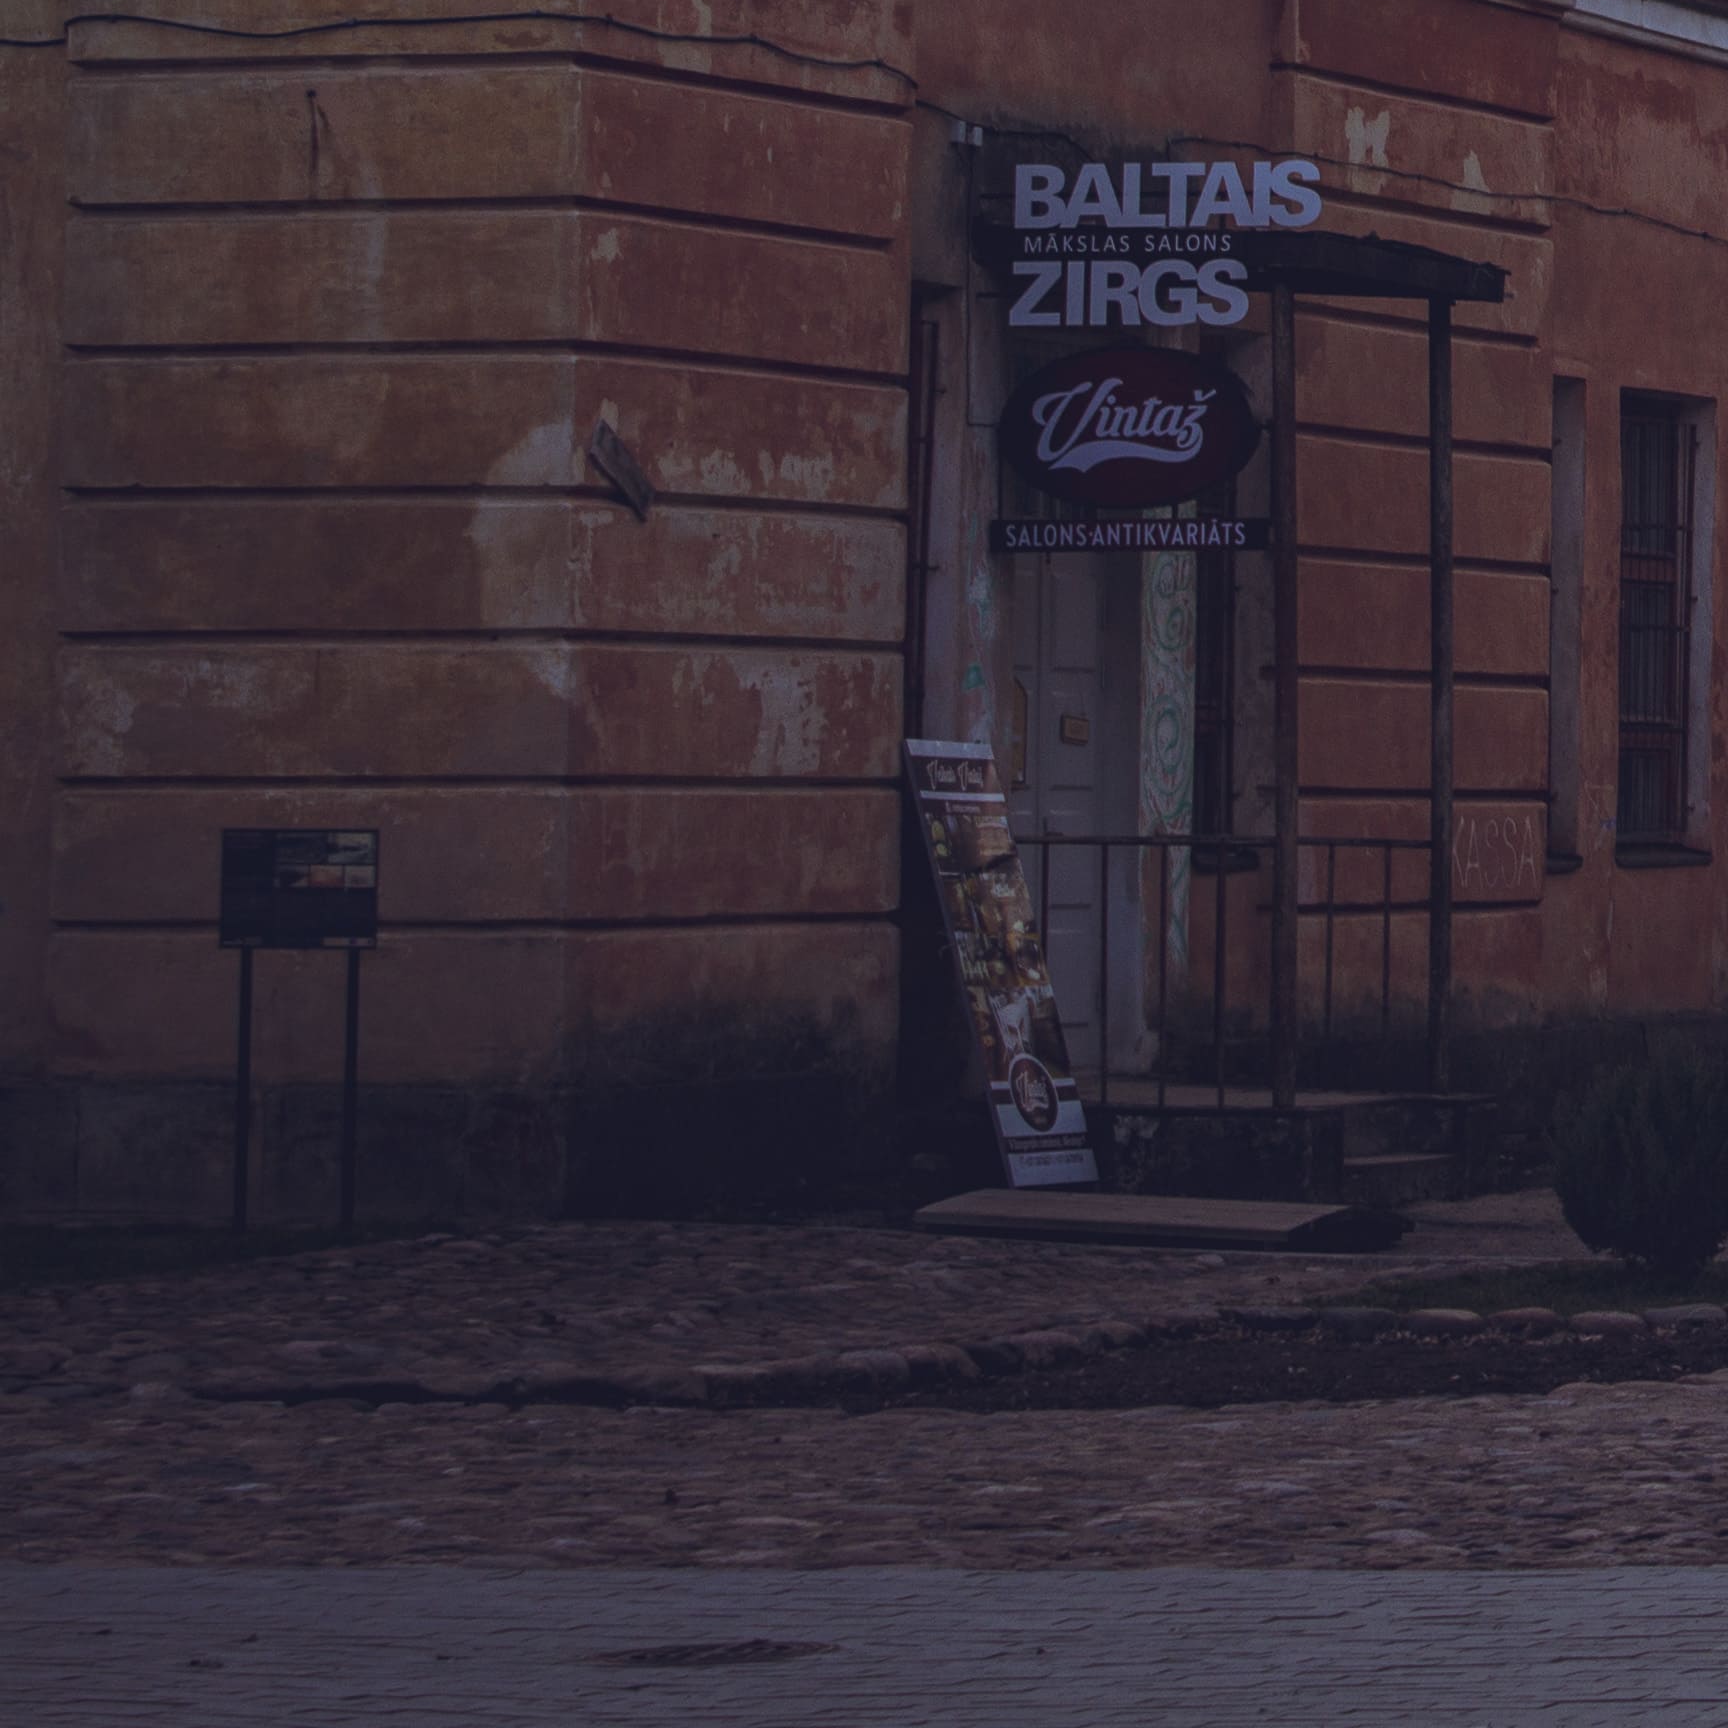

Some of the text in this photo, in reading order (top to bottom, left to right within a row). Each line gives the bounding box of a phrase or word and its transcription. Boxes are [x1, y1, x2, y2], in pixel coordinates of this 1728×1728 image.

[1013, 159, 1323, 230] BALTAIS
[1023, 232, 1233, 254] MĀKSLAS SALONS
[1008, 257, 1250, 327] ZIRGS
[1032, 377, 1217, 474] Vintaž
